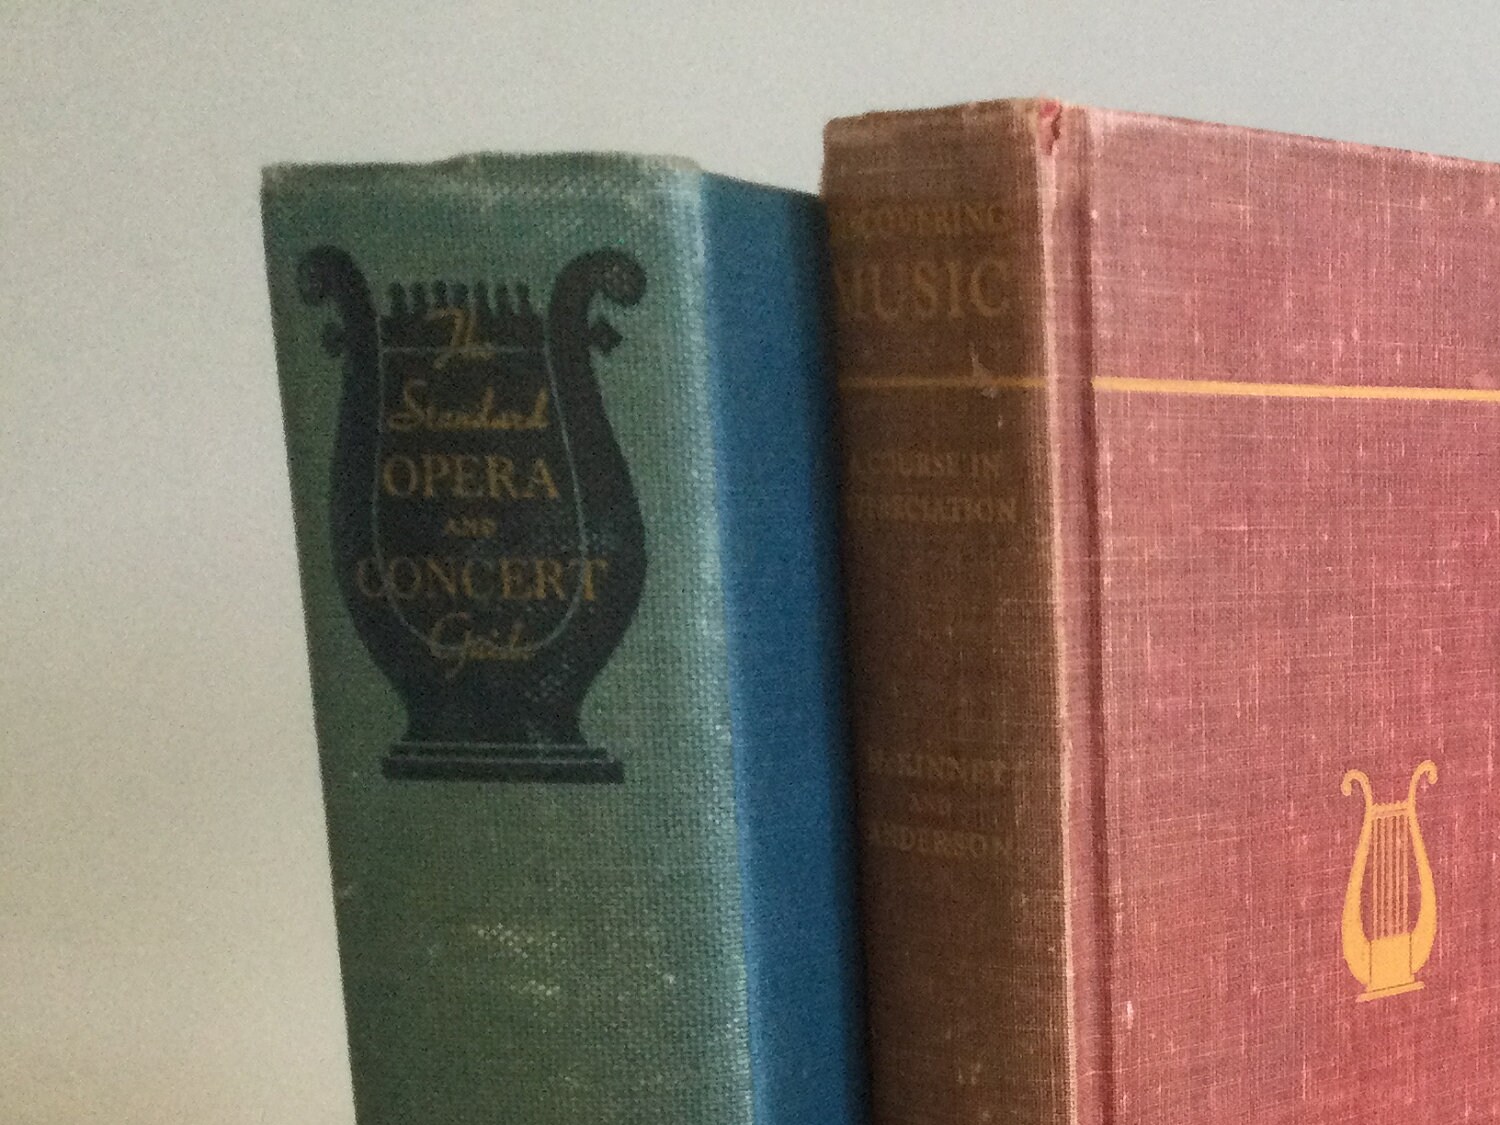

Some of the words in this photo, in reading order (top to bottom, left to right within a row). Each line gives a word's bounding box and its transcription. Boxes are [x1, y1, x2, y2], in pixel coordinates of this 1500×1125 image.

[381, 454, 560, 499] OPERA
[442, 517, 498, 539] AND
[355, 557, 611, 601] CONCERT
